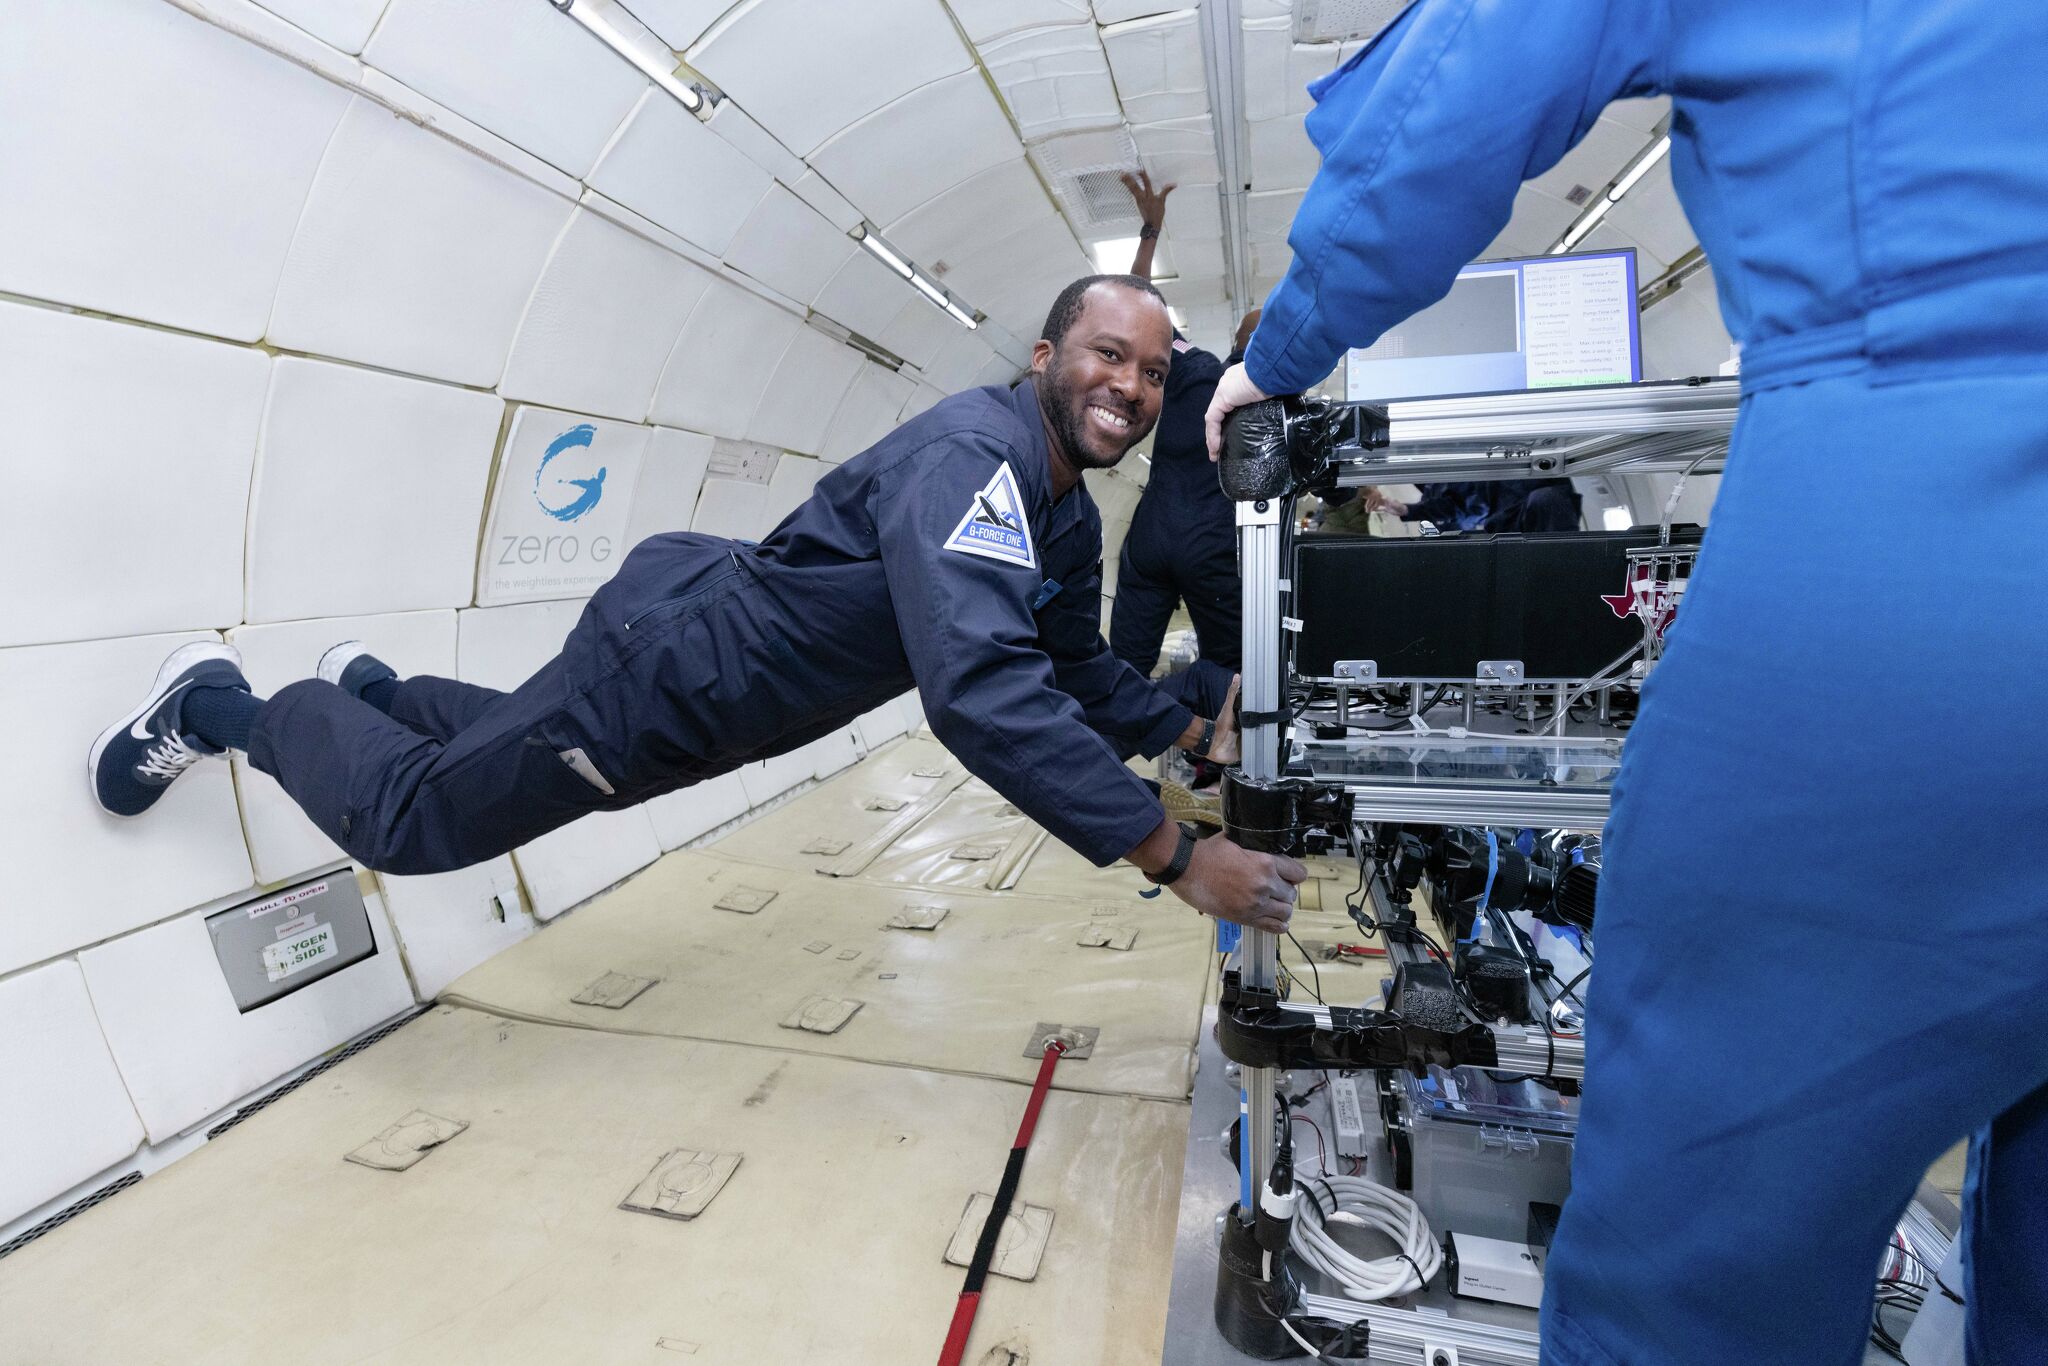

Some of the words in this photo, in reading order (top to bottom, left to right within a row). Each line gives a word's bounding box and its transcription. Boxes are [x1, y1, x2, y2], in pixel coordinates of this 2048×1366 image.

[969, 525, 1006, 543] G-FORCE
[1006, 534, 1022, 546] ONE
[498, 536, 579, 565] zero
[591, 536, 611, 562] G
[496, 577, 510, 589] the
[512, 574, 561, 591] weightless
[253, 901, 281, 915] PULL
[299, 884, 326, 899] OPEN
